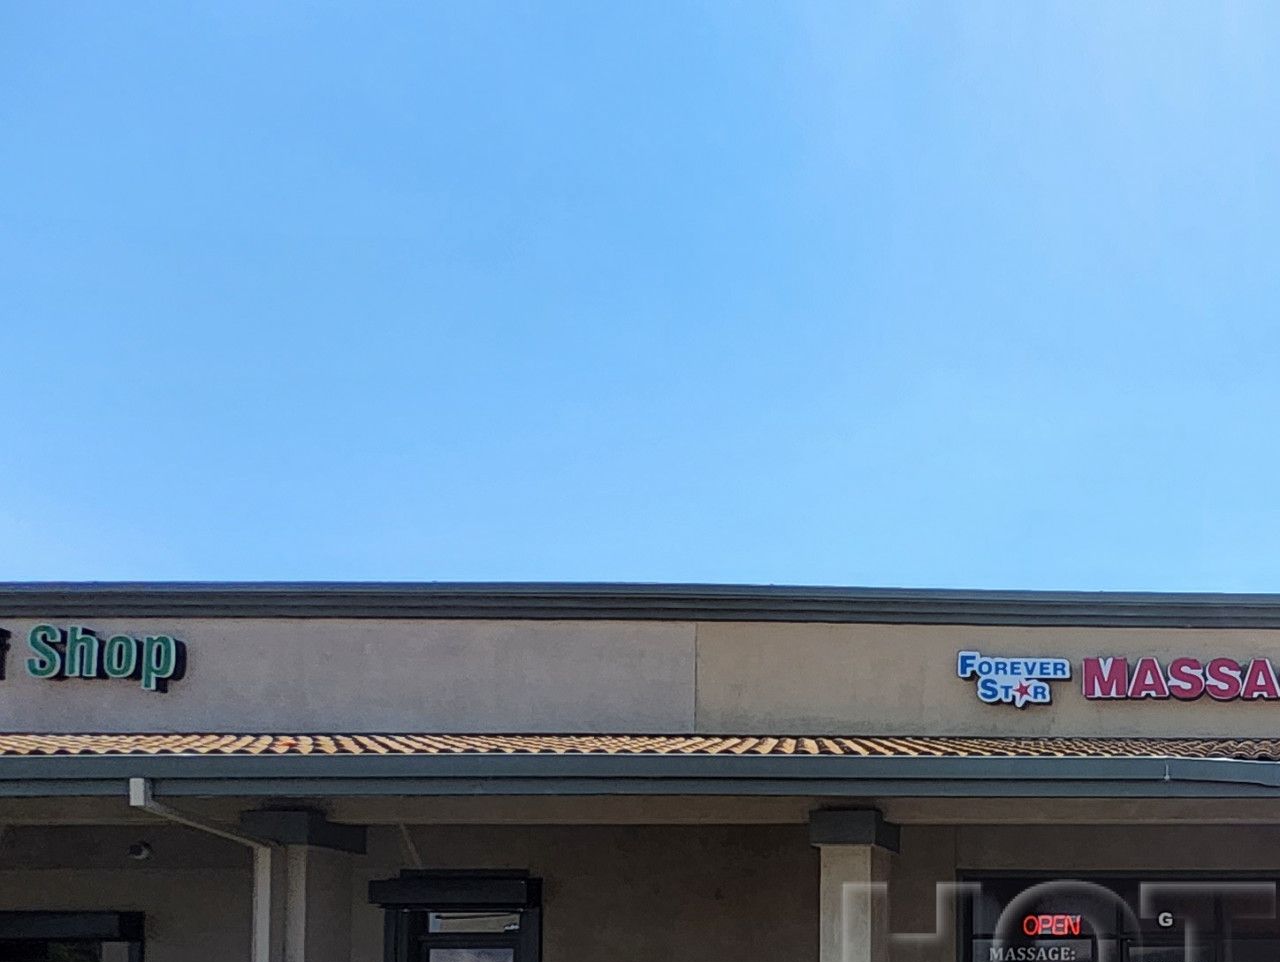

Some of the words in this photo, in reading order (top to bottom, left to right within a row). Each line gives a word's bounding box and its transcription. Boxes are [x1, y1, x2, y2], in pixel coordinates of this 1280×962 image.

[25, 623, 177, 690] Shop
[959, 653, 1067, 676] FOREVER
[1022, 914, 1082, 936] OPEN
[1158, 911, 1174, 927] G
[989, 947, 1076, 961] MASSAGE:
